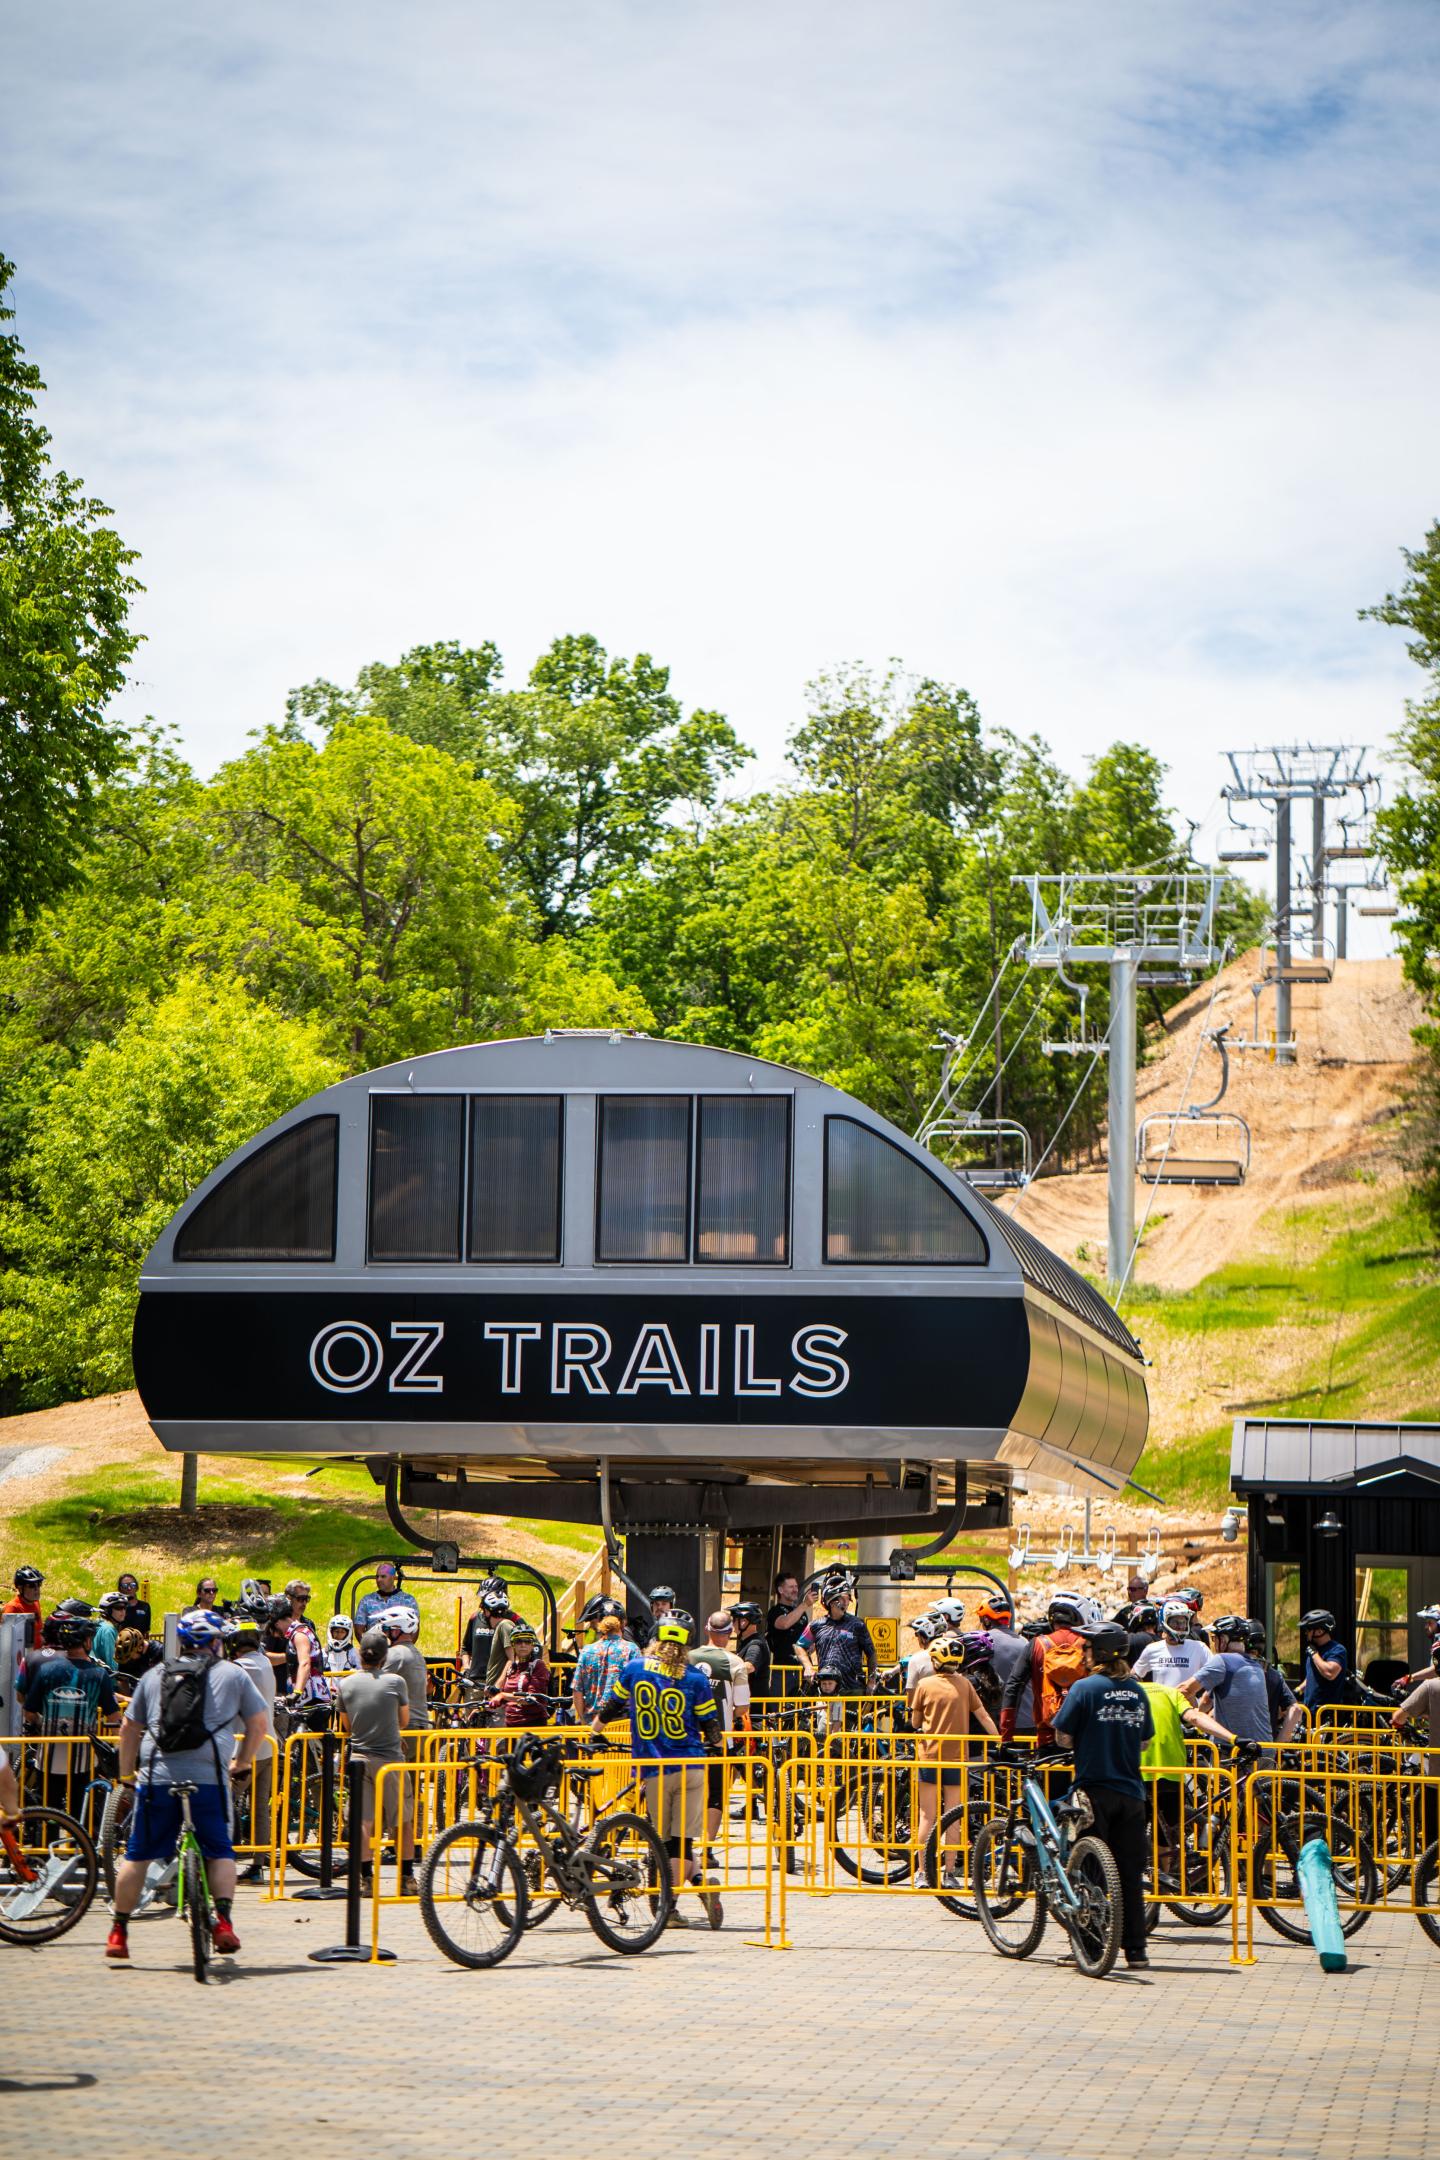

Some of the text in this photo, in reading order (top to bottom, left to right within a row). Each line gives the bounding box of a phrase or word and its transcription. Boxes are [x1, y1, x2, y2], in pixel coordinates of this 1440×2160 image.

[309, 1320, 850, 1397] OZ TRAILS
[634, 1680, 688, 1740] 88
[1104, 1690, 1139, 1700] CANCUN
